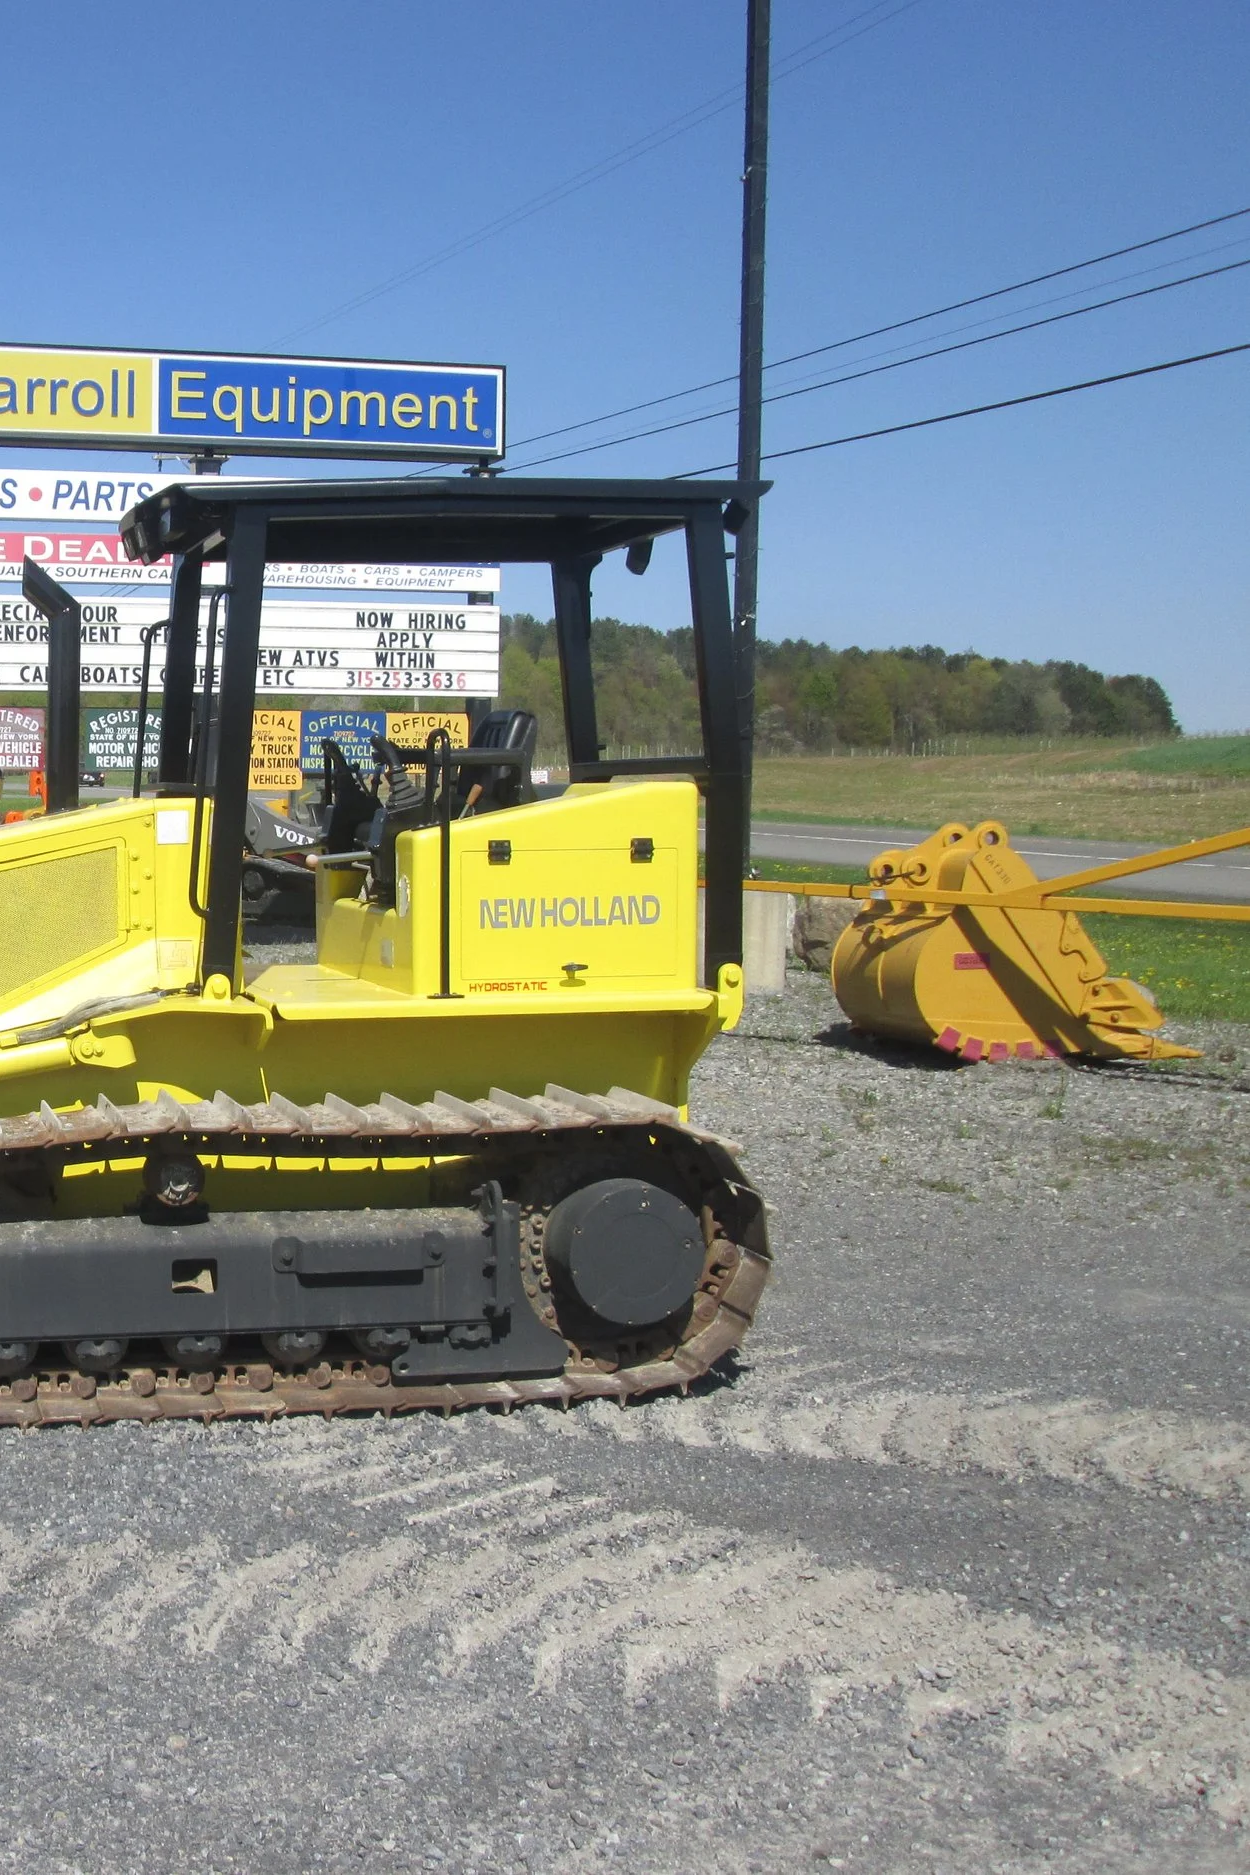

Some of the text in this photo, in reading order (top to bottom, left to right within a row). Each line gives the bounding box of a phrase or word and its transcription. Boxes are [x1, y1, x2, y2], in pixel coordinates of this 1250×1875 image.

[170, 370, 479, 435] Equipment
[52, 479, 154, 512] PARTS
[23, 535, 174, 563] DEAL
[55, 566, 143, 579] SOUTHERN
[300, 564, 483, 578] BOATS CARS CAMPERS
[263, 575, 455, 588] AREHOUSING EQUIPMENT
[81, 605, 118, 623] OUR
[356, 611, 467, 630] NOW HIRING
[377, 631, 434, 649] APPLY
[258, 650, 339, 667] EW ATVS
[375, 651, 436, 669] WITHIN
[81, 667, 143, 685] BOATS
[263, 669, 295, 686] ETC
[346, 670, 467, 690] 315-253-3636
[90, 710, 162, 732] REGISTRE
[254, 713, 296, 732] ICIAL
[308, 715, 380, 734] OFFICIAL
[391, 716, 461, 734] OFFICIAL
[89, 742, 125, 754] MOTOR
[261, 744, 294, 755] TRUCK
[0, 755, 40, 767] DEALER
[96, 756, 134, 767] REPAIR
[267, 757, 300, 769] STATION
[253, 774, 297, 785] VEHICLES
[480, 894, 661, 929] NEW HOLLAND
[469, 981, 548, 992] HYDROSTATIC
